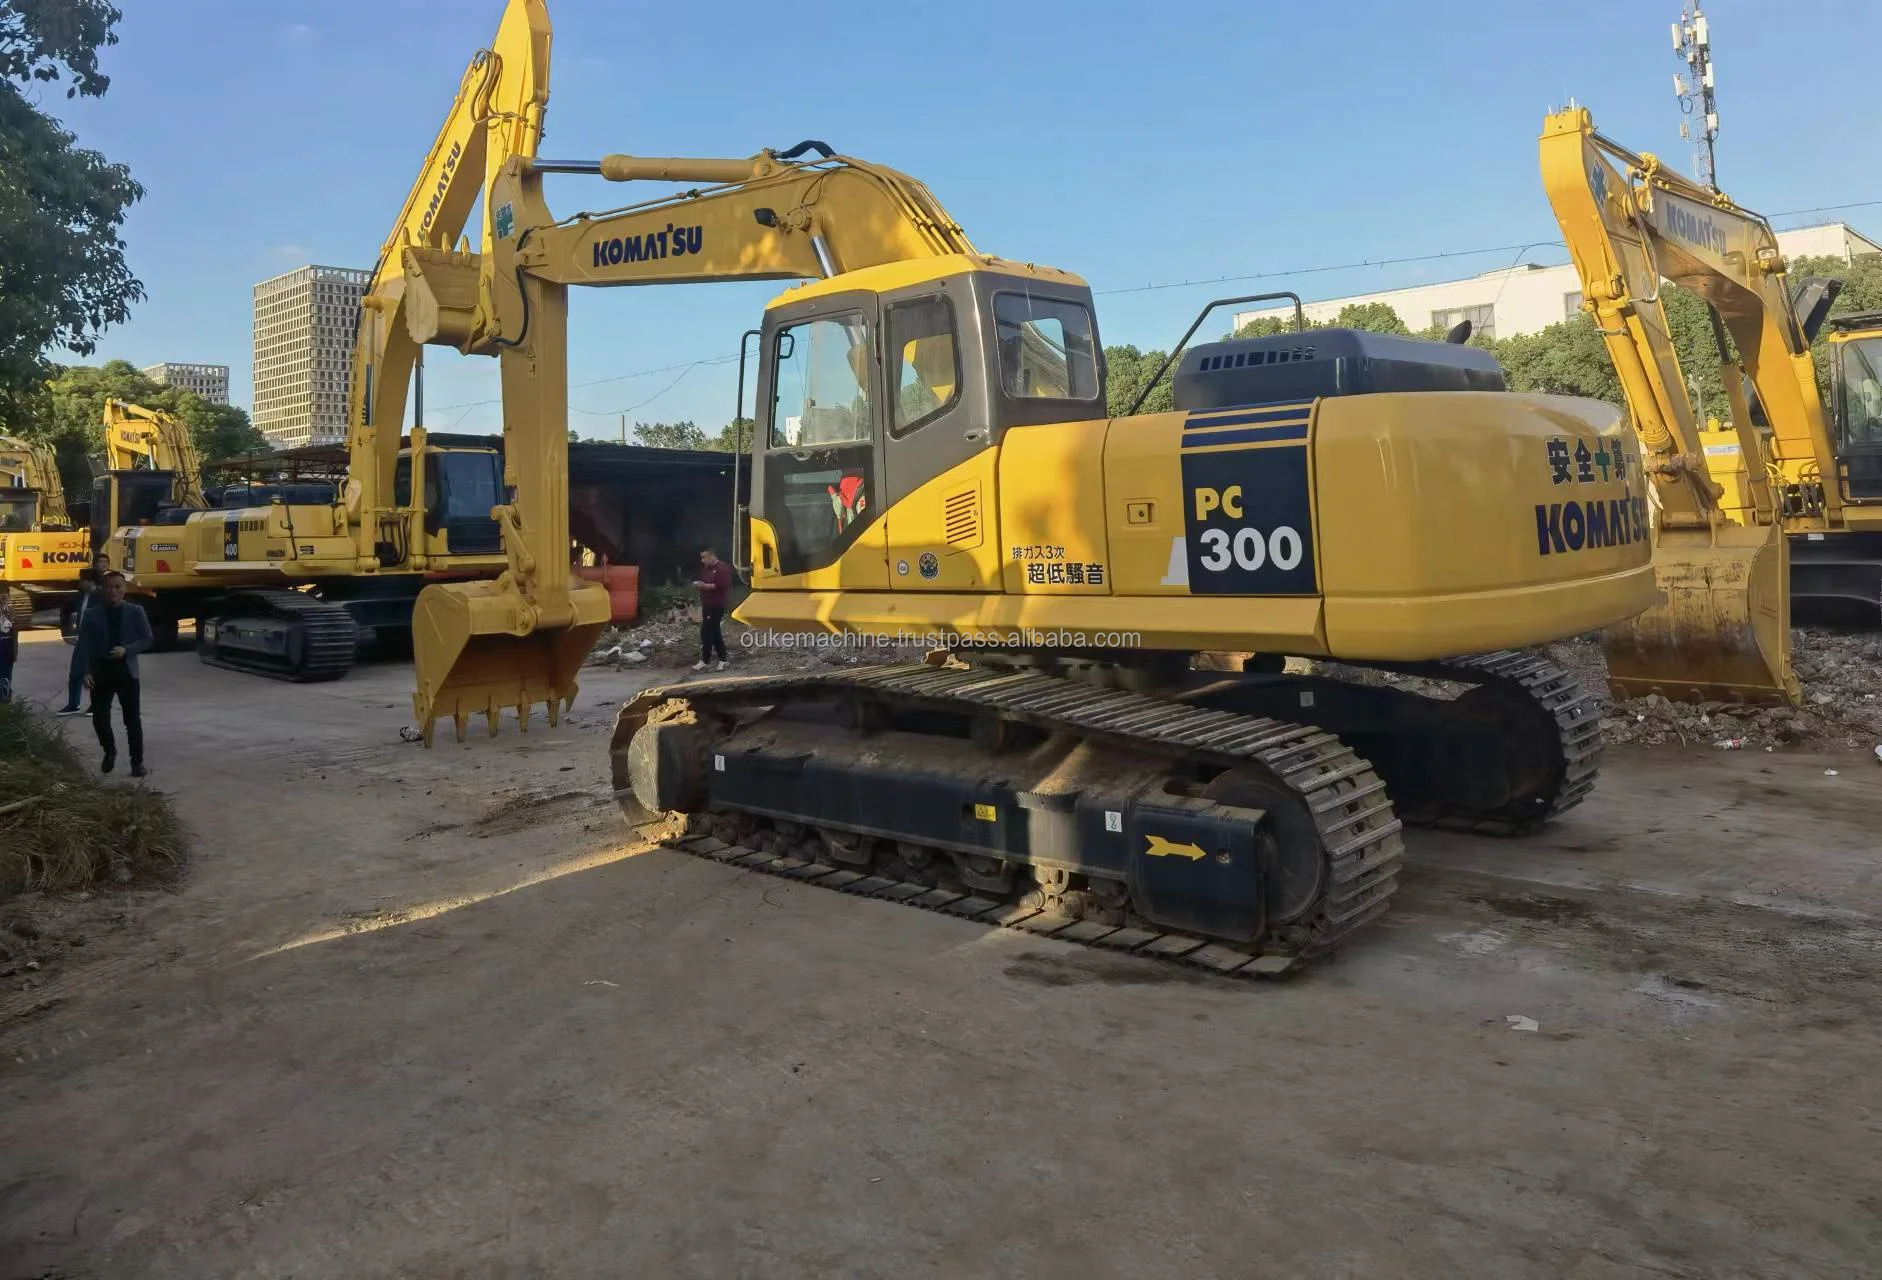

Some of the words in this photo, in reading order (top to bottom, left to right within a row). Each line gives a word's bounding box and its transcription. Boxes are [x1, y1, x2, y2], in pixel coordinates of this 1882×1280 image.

[417, 140, 461, 243] KOMATSU
[593, 223, 703, 268] KOMATSU
[1666, 201, 1726, 257] KOMATSU
[1195, 485, 1243, 521] PC
[225, 543, 238, 557] 400
[1200, 526, 1303, 572] 300
